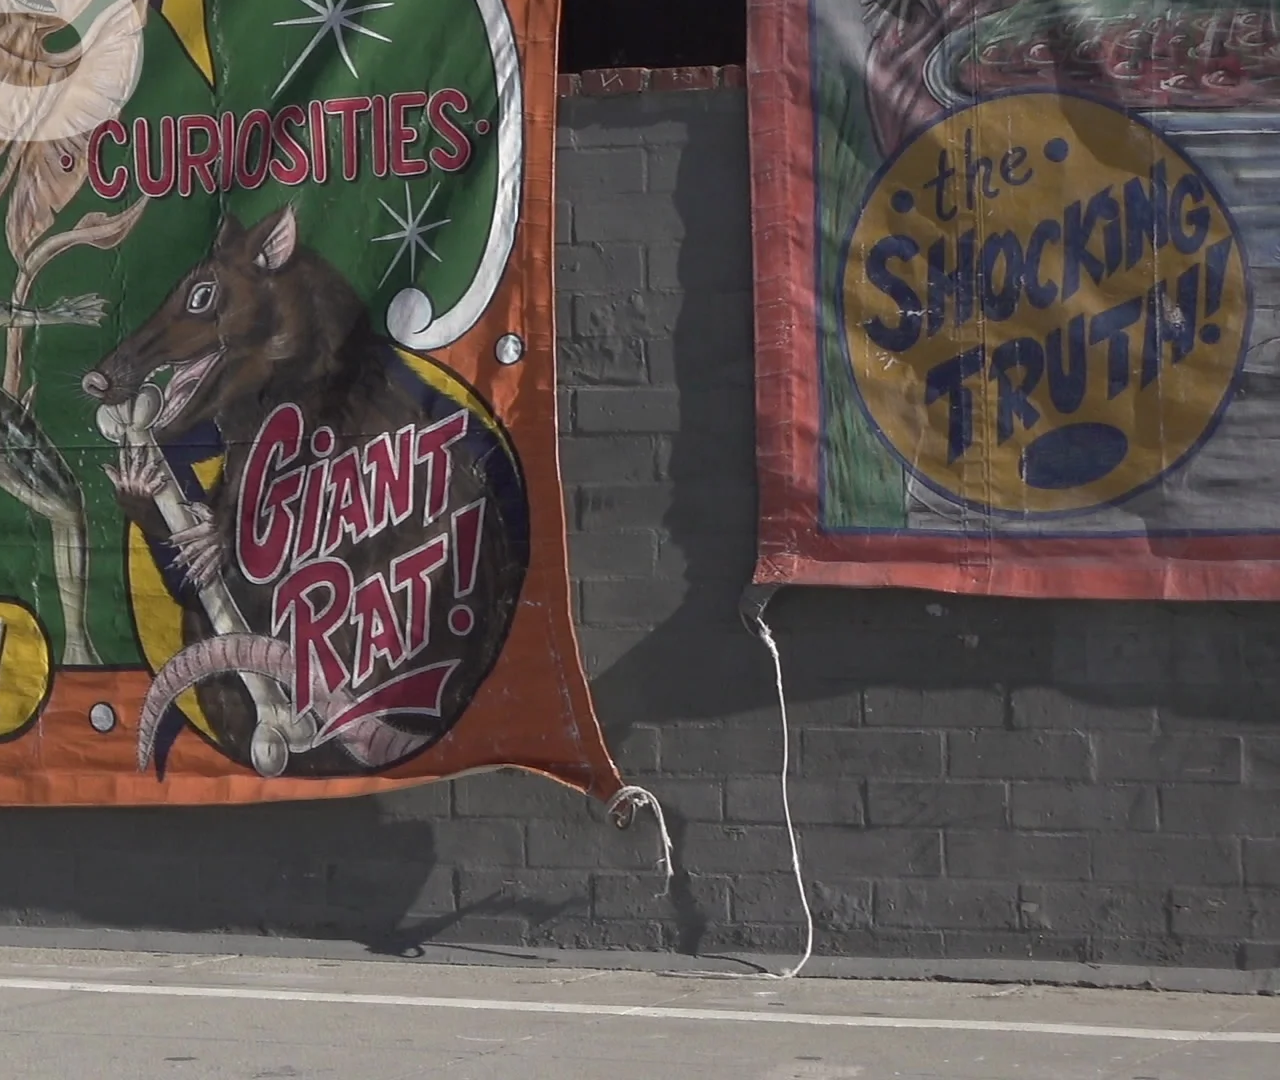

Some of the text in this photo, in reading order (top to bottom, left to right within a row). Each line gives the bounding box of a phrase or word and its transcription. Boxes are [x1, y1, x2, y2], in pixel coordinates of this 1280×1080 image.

[88, 88, 473, 198] CURIOSITIES
[925, 128, 1033, 221] the
[926, 235, 1231, 465] TRUTH!
[272, 498, 486, 720] RAT!
